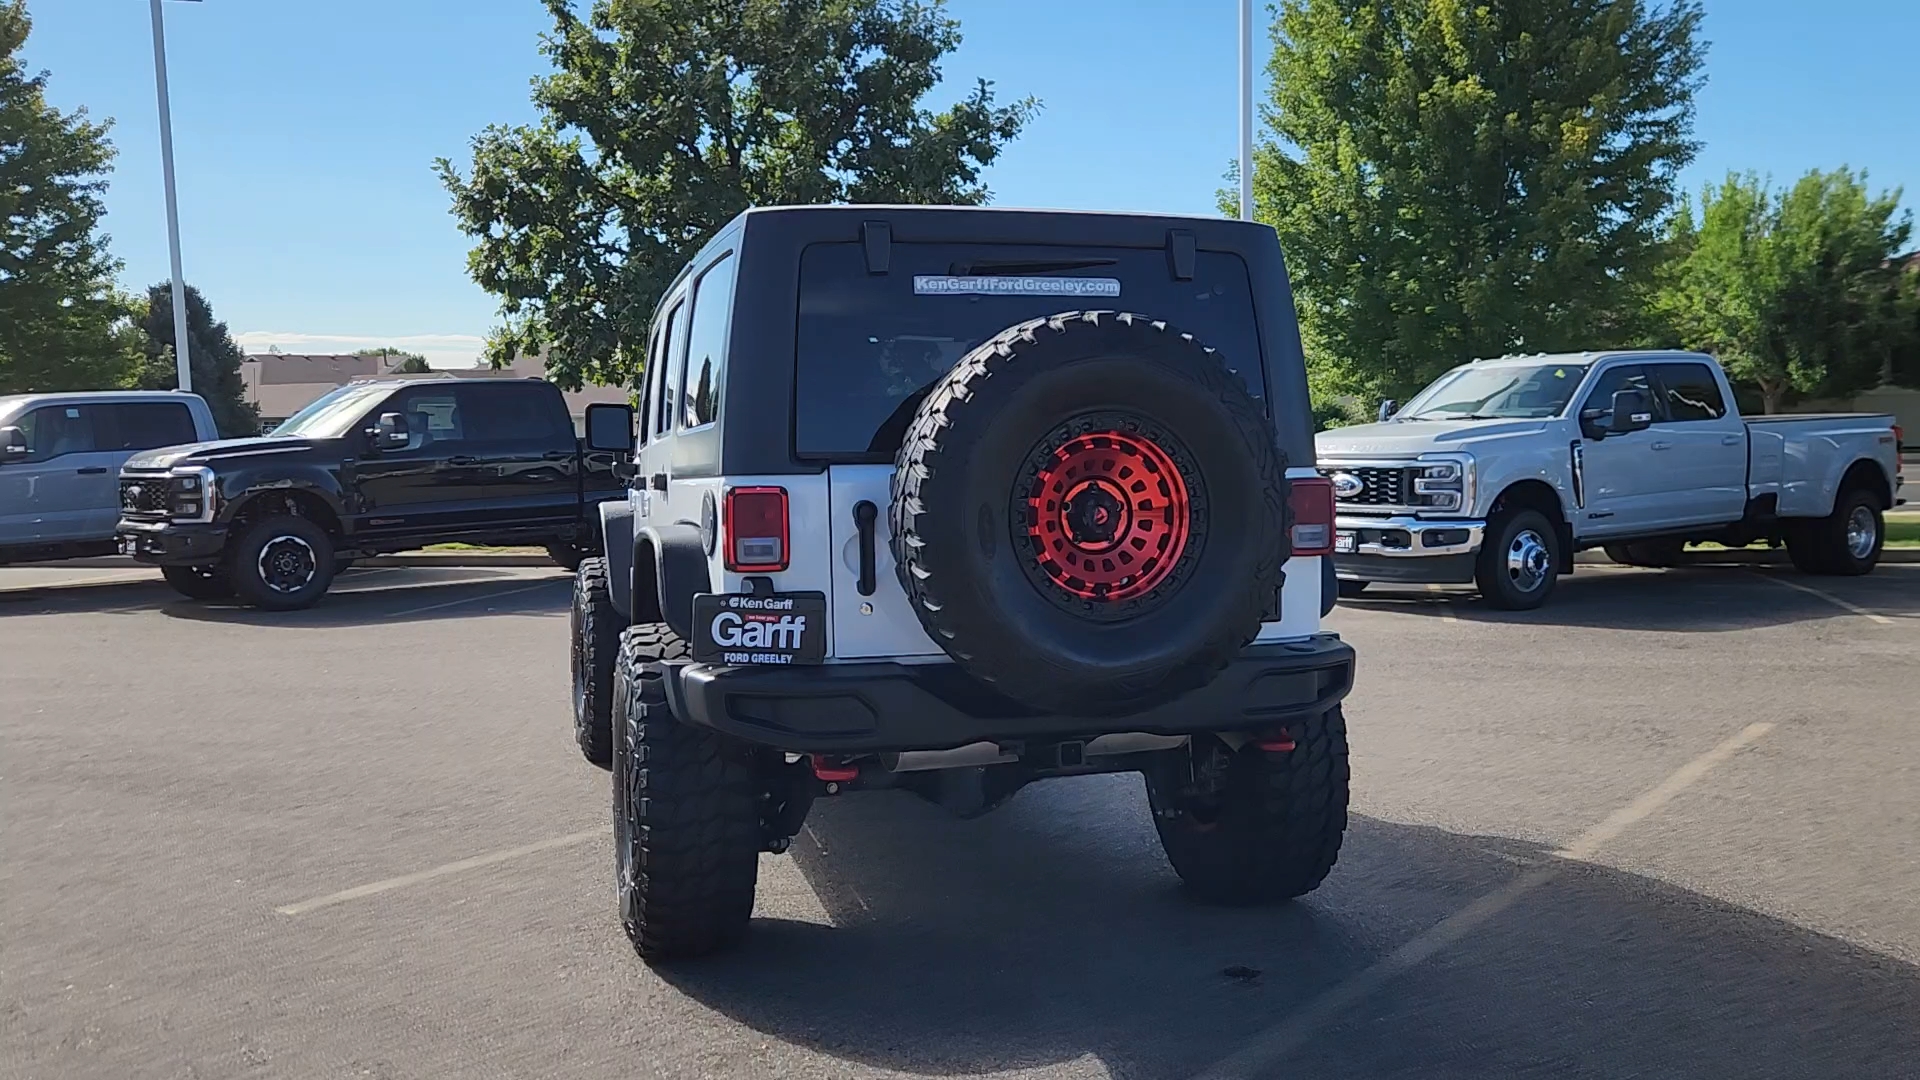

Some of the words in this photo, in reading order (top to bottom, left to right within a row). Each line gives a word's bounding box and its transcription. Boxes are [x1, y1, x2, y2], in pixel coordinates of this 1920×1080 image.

[915, 278, 1118, 294] KenGarffFordGreeley.com
[1335, 536, 1353, 548] arff
[740, 597, 763, 609] Ken
[764, 599, 793, 610] Garff
[711, 612, 805, 649] Garff
[724, 653, 749, 663] FORD
[751, 653, 793, 664] GREELEY
